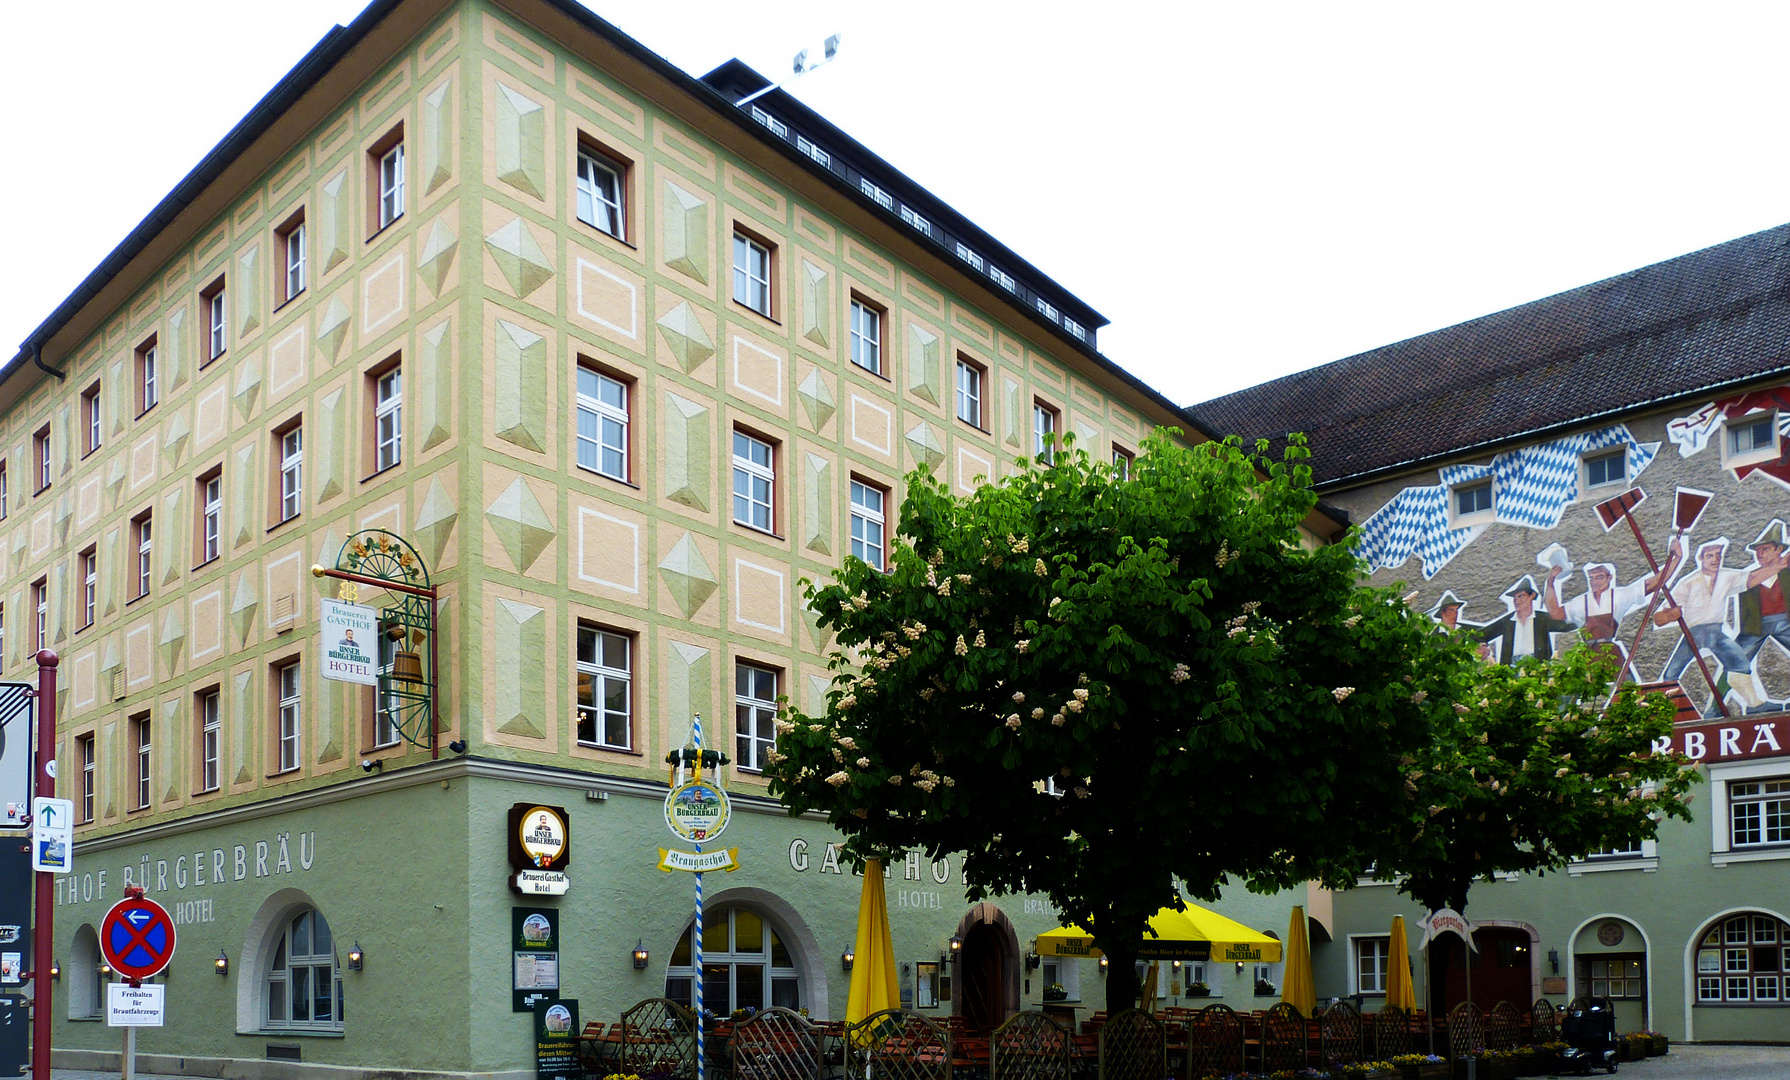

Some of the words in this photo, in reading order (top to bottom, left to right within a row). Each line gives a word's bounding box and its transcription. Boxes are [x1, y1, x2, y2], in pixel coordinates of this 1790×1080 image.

[332, 606, 367, 619] Brauerei
[327, 615, 372, 630] GASTHOF
[339, 645, 360, 656] UNSER
[329, 660, 370, 676] HOTEL
[534, 830, 552, 838] UNSER
[123, 831, 316, 895] BÜRGERBRÄU
[670, 852, 726, 868] Braugasthof
[522, 871, 544, 881] Brauerei
[545, 873, 565, 883] Gasthof
[534, 882, 551, 892] Hotel
[898, 890, 943, 910] HOTEL
[176, 899, 215, 925] HOTEL
[1432, 916, 1464, 933] Biergarten
[1066, 938, 1083, 947] UNSER
[1233, 943, 1250, 951] UNSER
[122, 990, 153, 998] Freihalten
[113, 1008, 159, 1016] Brautfahrzeuge
